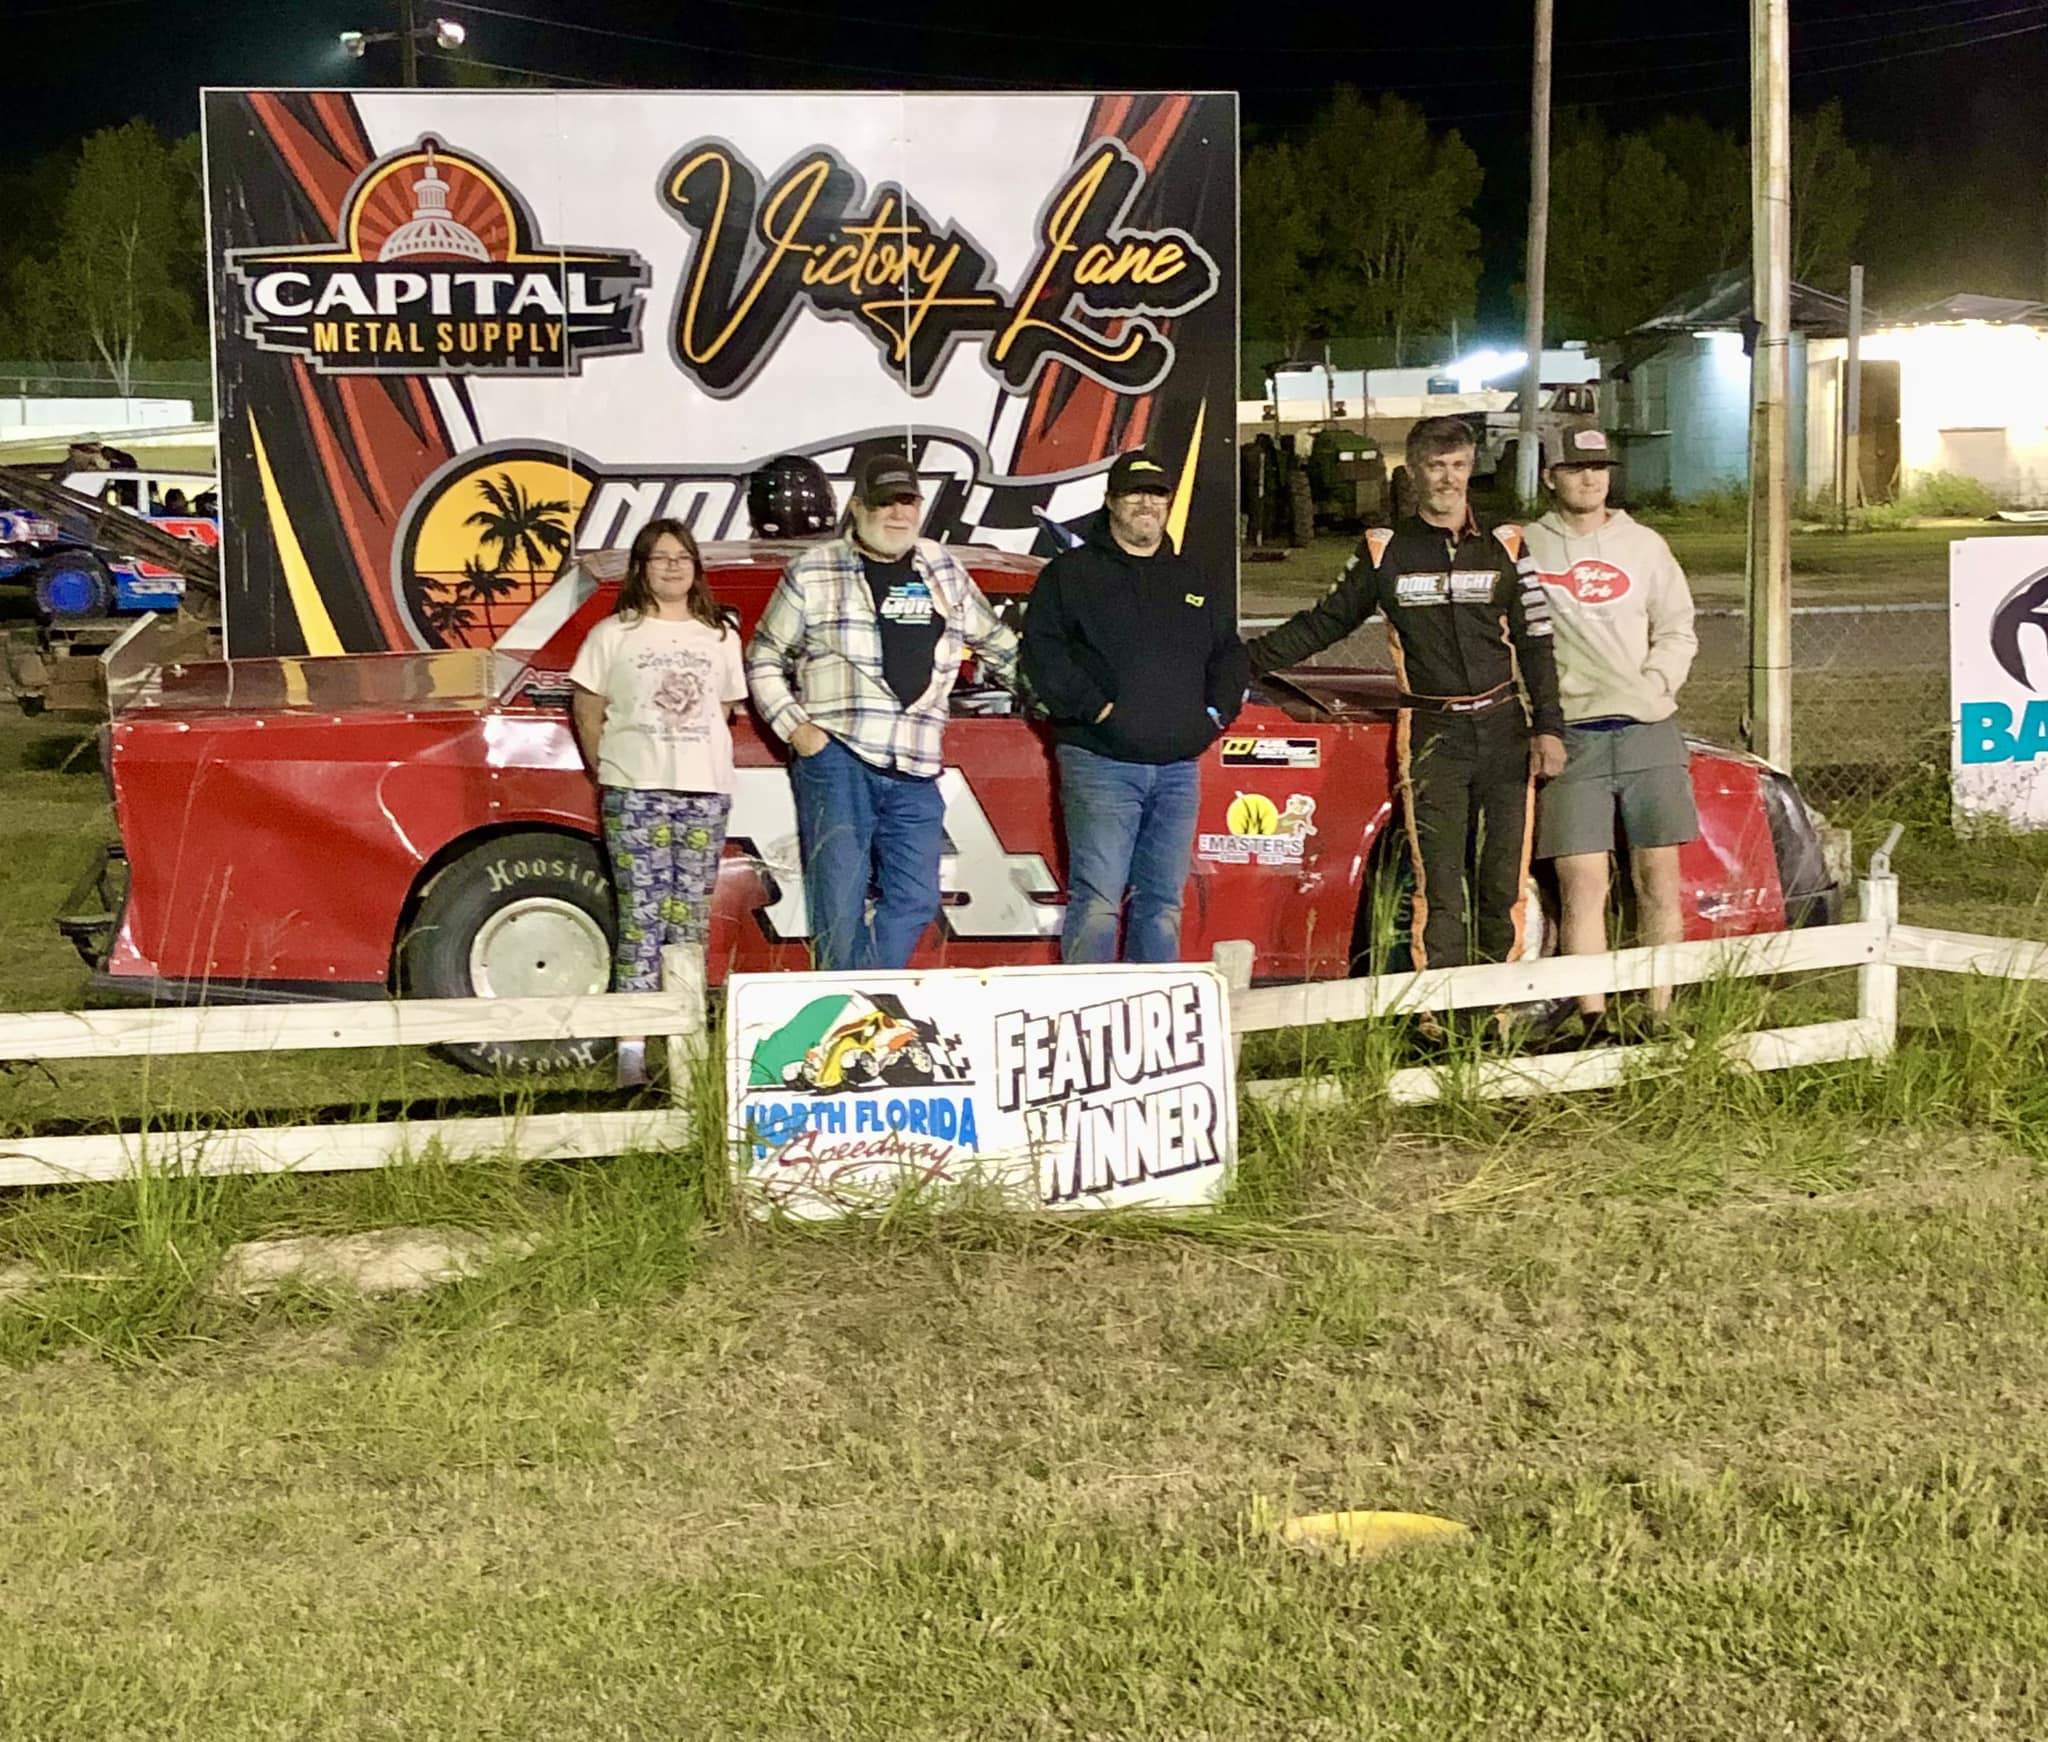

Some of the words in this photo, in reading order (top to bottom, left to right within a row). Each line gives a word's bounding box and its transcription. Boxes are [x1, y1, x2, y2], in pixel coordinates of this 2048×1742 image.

[672, 151, 997, 363] Victory
[994, 151, 1188, 363] Lane
[253, 270, 617, 316] CAPITAL
[312, 321, 425, 353] METAL
[436, 321, 562, 353] SUPPLY
[486, 858, 611, 894] Hoosier
[994, 982, 1206, 1112] FEATURE
[744, 1100, 847, 1160] NORTH
[855, 1096, 980, 1154] FLORIDA
[1024, 1081, 1221, 1205] WINNER
[778, 1130, 955, 1188] Speedway
